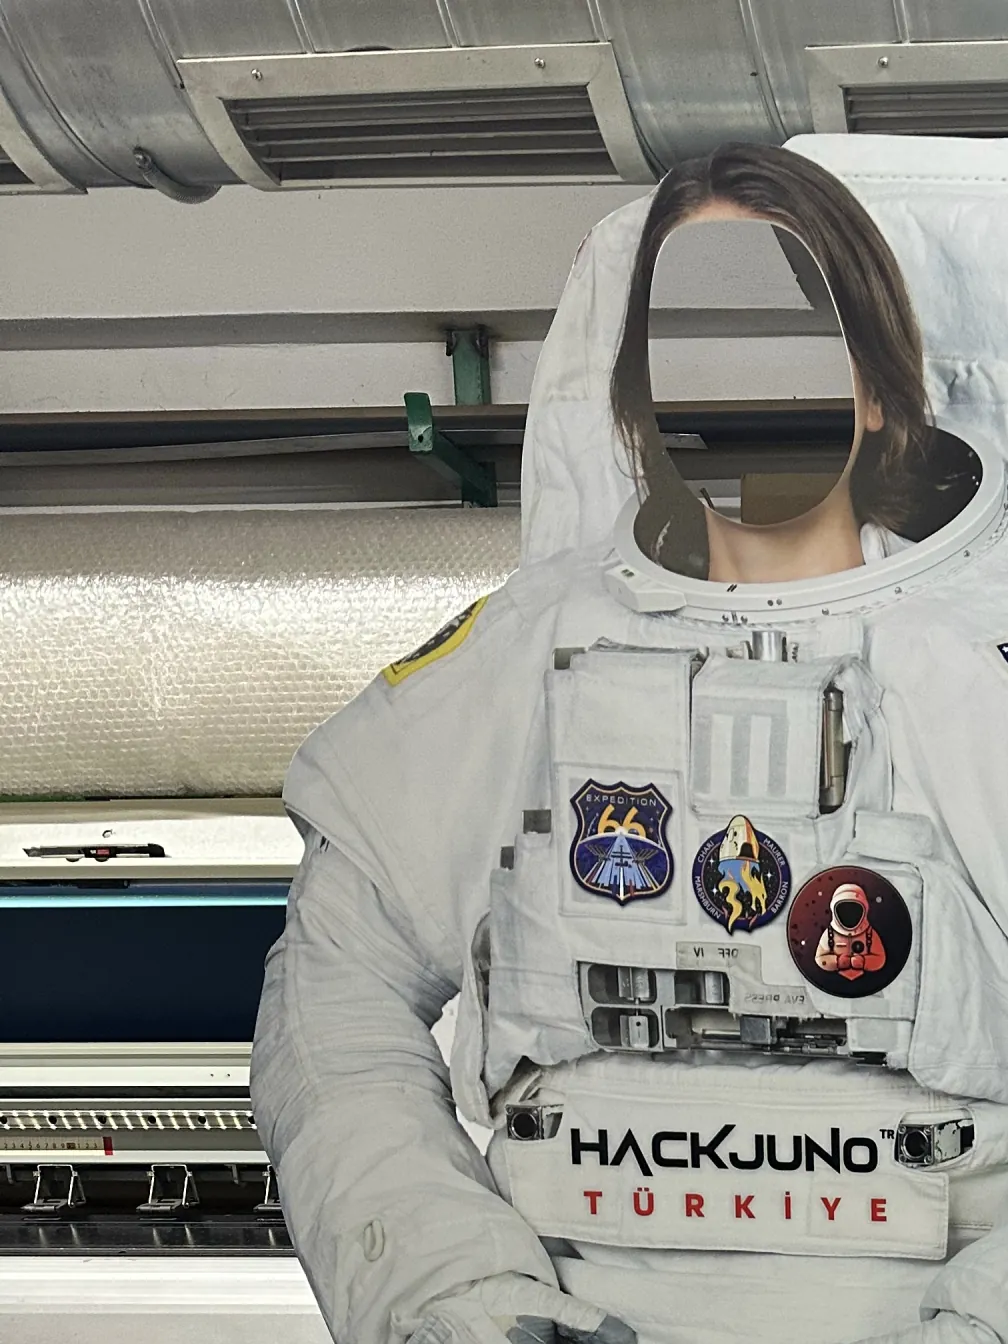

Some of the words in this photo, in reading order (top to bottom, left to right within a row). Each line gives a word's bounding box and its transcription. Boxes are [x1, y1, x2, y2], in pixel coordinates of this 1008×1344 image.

[586, 794, 658, 807] EXPEDITION
[597, 803, 647, 839] 66
[697, 840, 715, 864] CHARI
[763, 837, 786, 867] MAURER
[694, 875, 722, 920] MARSHBURN
[770, 880, 789, 914] BARRON
[879, 1128, 895, 1140] TR
[583, 1186, 888, 1222] TÜRKİYE
